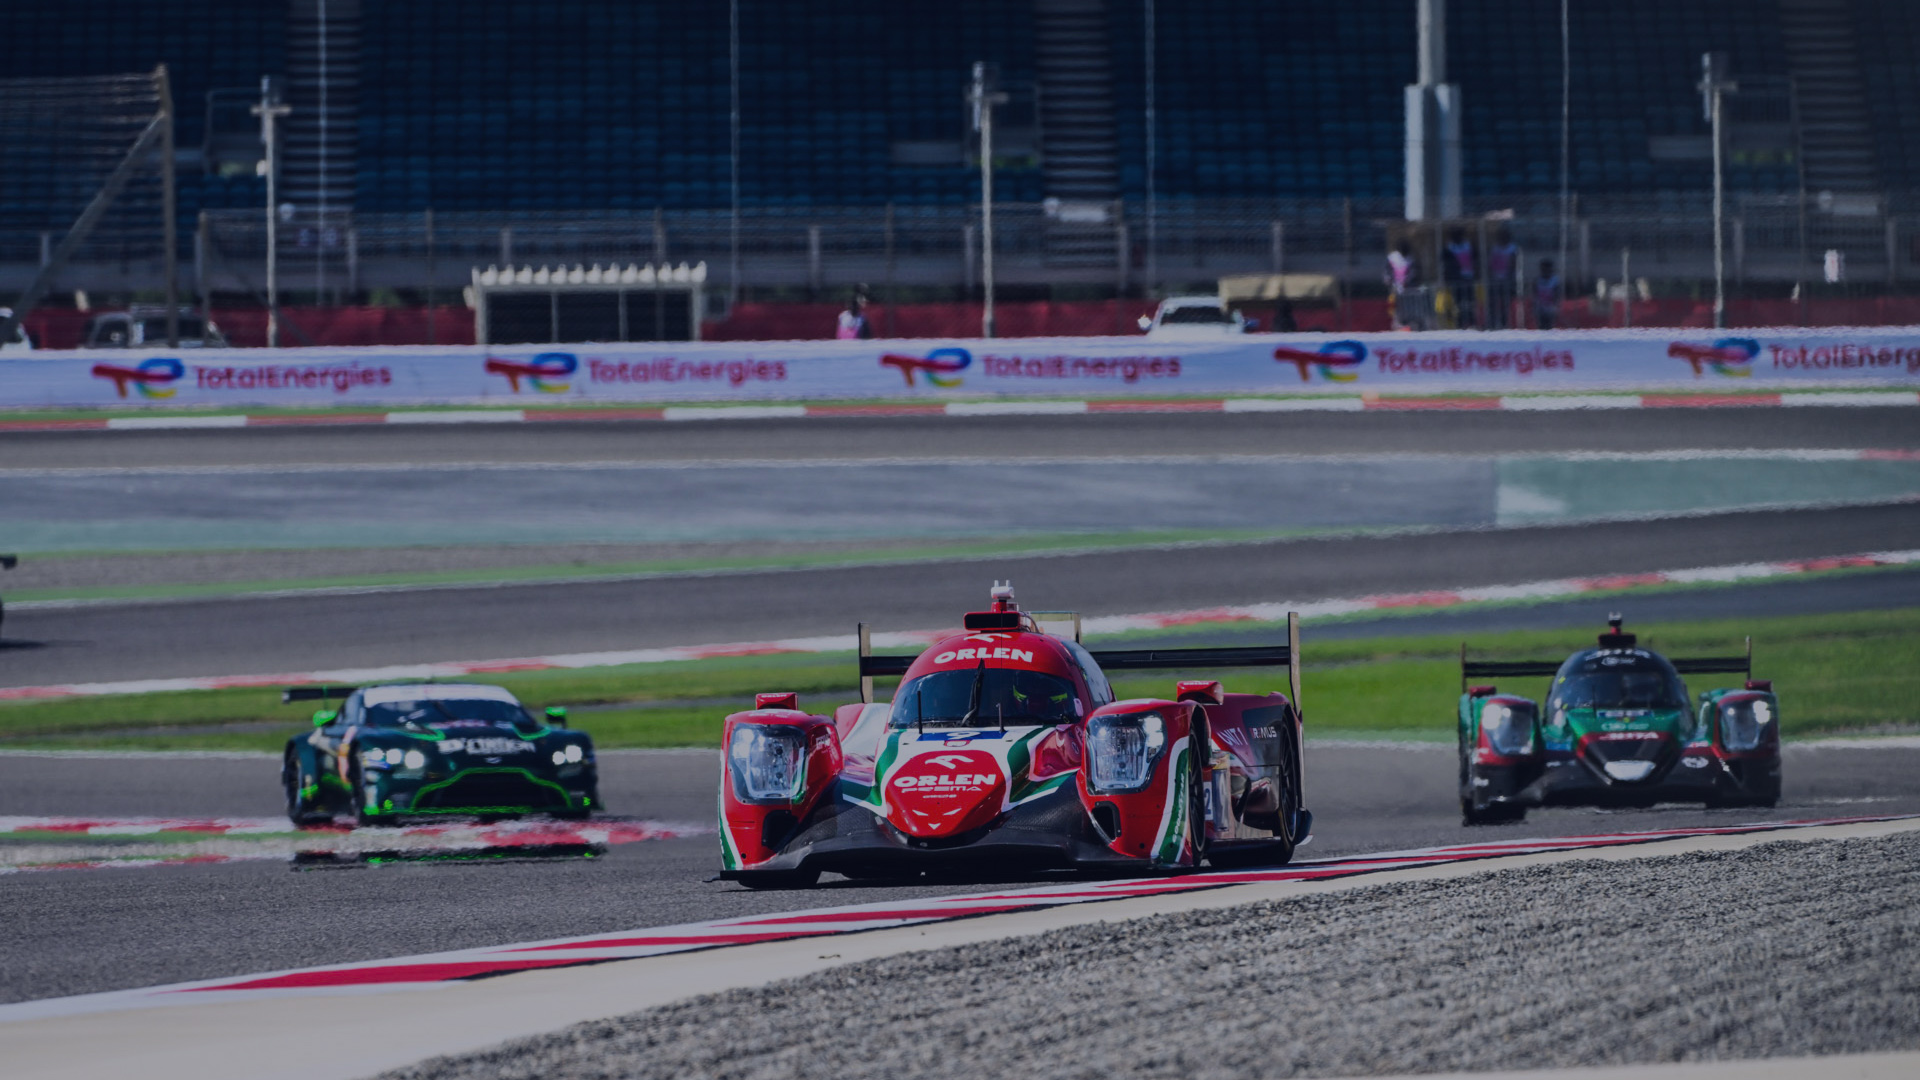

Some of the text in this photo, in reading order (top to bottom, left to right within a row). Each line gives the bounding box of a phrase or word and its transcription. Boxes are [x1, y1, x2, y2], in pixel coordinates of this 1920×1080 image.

[587, 355, 785, 386] TotalEnergies
[983, 355, 1180, 383] TotalEnergies
[1374, 345, 1574, 376] TotalEnergies
[194, 362, 391, 392] TotalEnergies
[934, 647, 1033, 664] ORLEN
[894, 774, 996, 787] ORLEN
